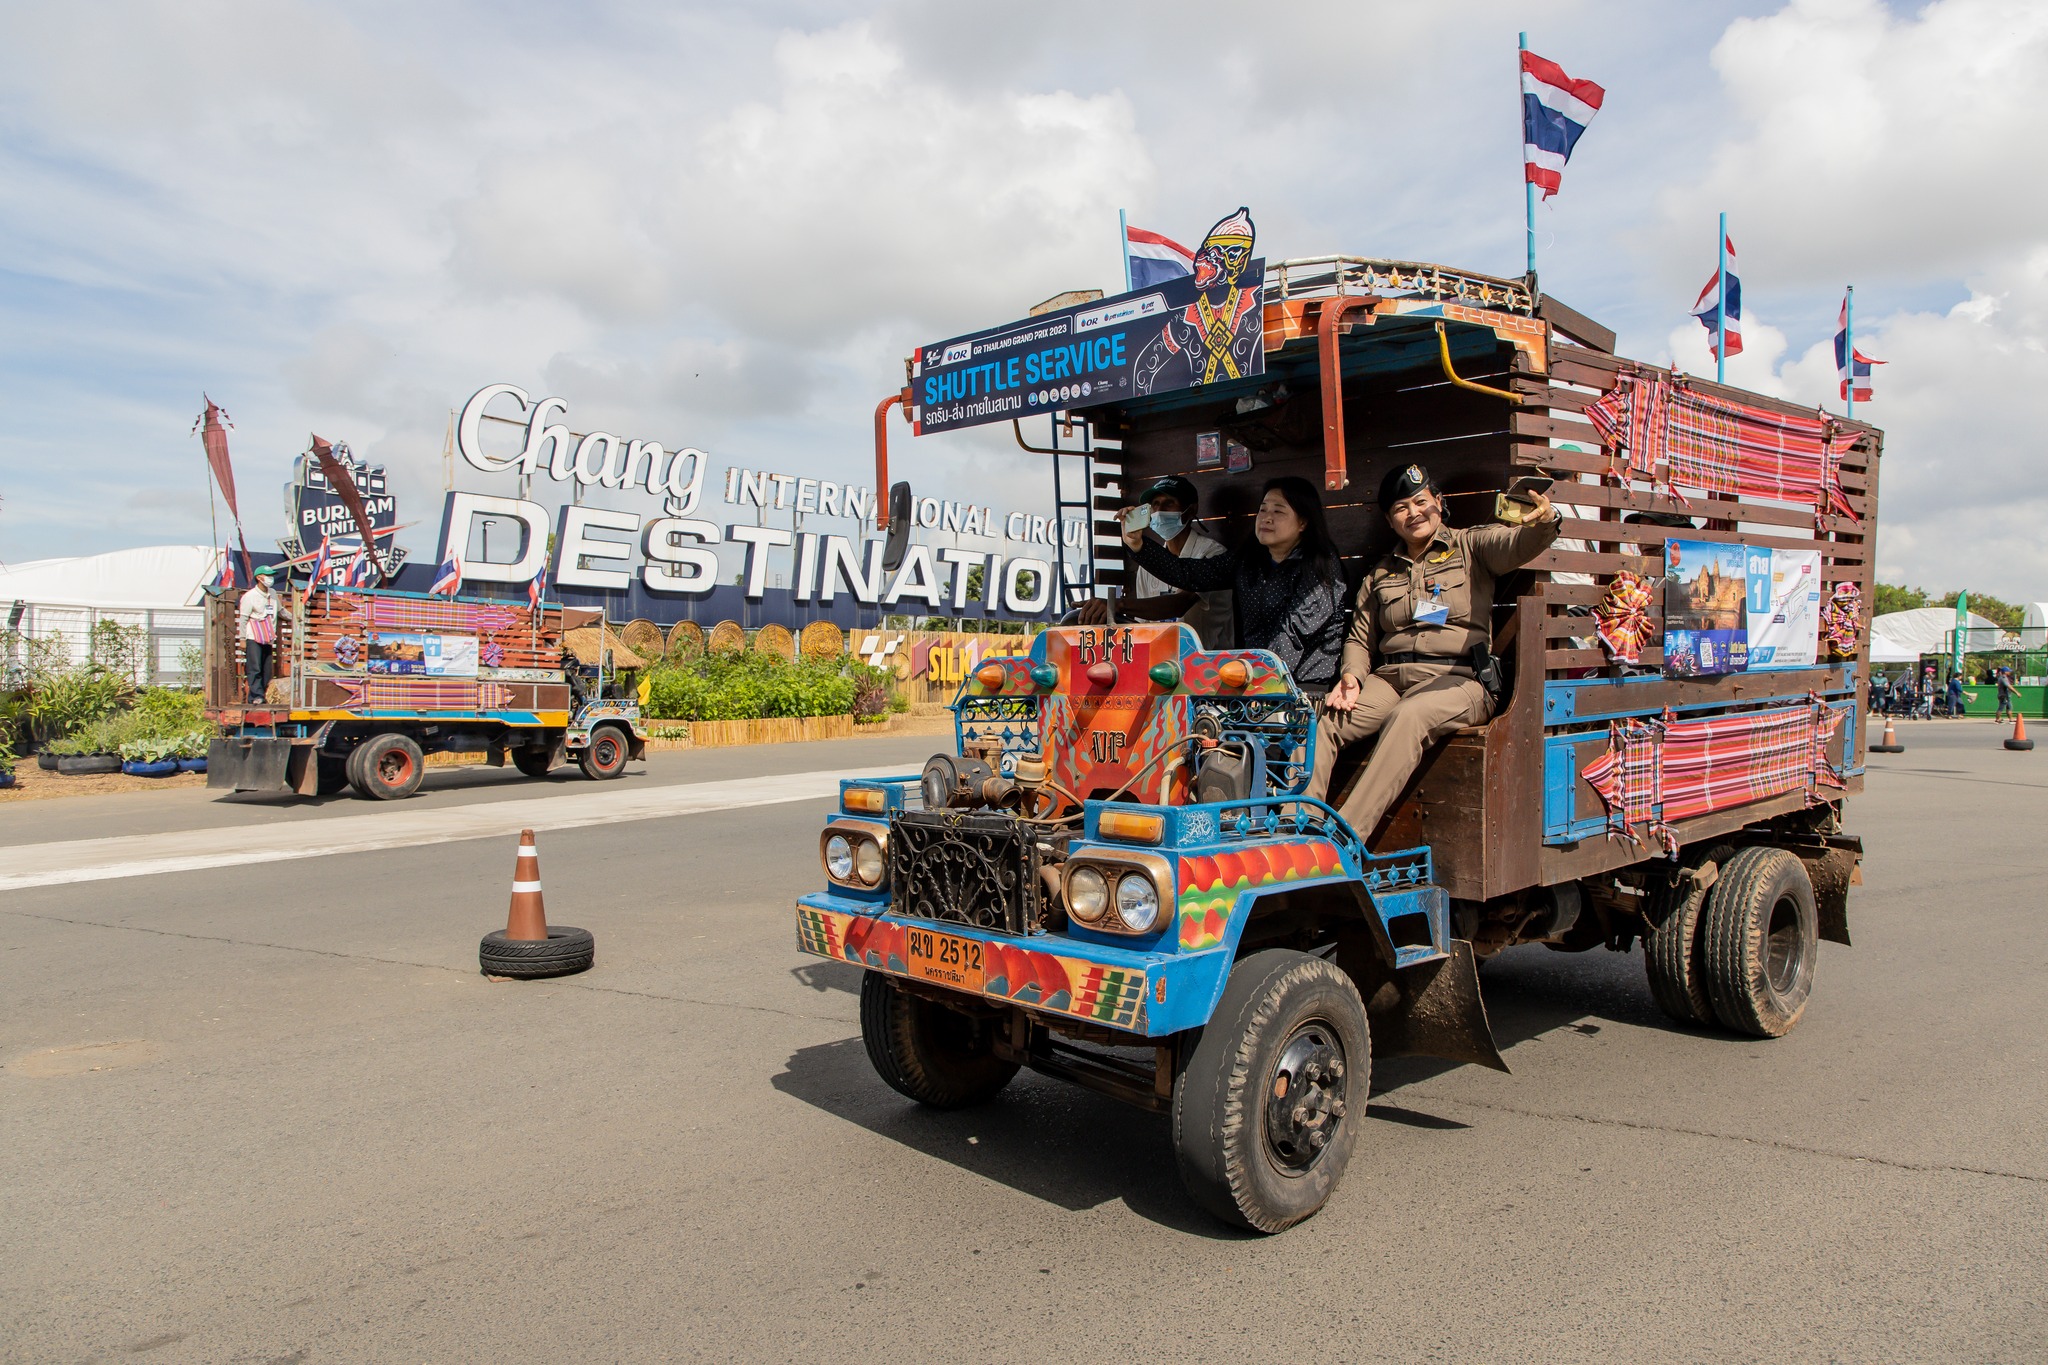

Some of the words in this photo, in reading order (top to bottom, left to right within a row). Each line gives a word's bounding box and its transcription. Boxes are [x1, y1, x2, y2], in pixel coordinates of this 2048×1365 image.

[1086, 317, 1099, 327] OR
[953, 349, 968, 360] OR
[973, 346, 982, 355] OR
[983, 337, 1012, 352] THAILAND
[1012, 331, 1034, 345] GRAND
[1034, 328, 1049, 341] PRIX
[1049, 323, 1068, 337] 2023
[925, 357, 1021, 406] SHUTTLE
[1025, 332, 1127, 385] SERVICE
[966, 395, 1022, 419] ภายในสนาม
[458, 383, 709, 518] Chang
[302, 496, 393, 526] BURIAM
[320, 516, 376, 537] UNITD
[1005, 511, 1088, 550] CIRCUI
[436, 490, 1091, 614] DESTINATION
[1749, 554, 1769, 575] สาย
[1753, 579, 1763, 610] 1
[928, 646, 973, 682] SILK
[940, 937, 981, 971] 2512
